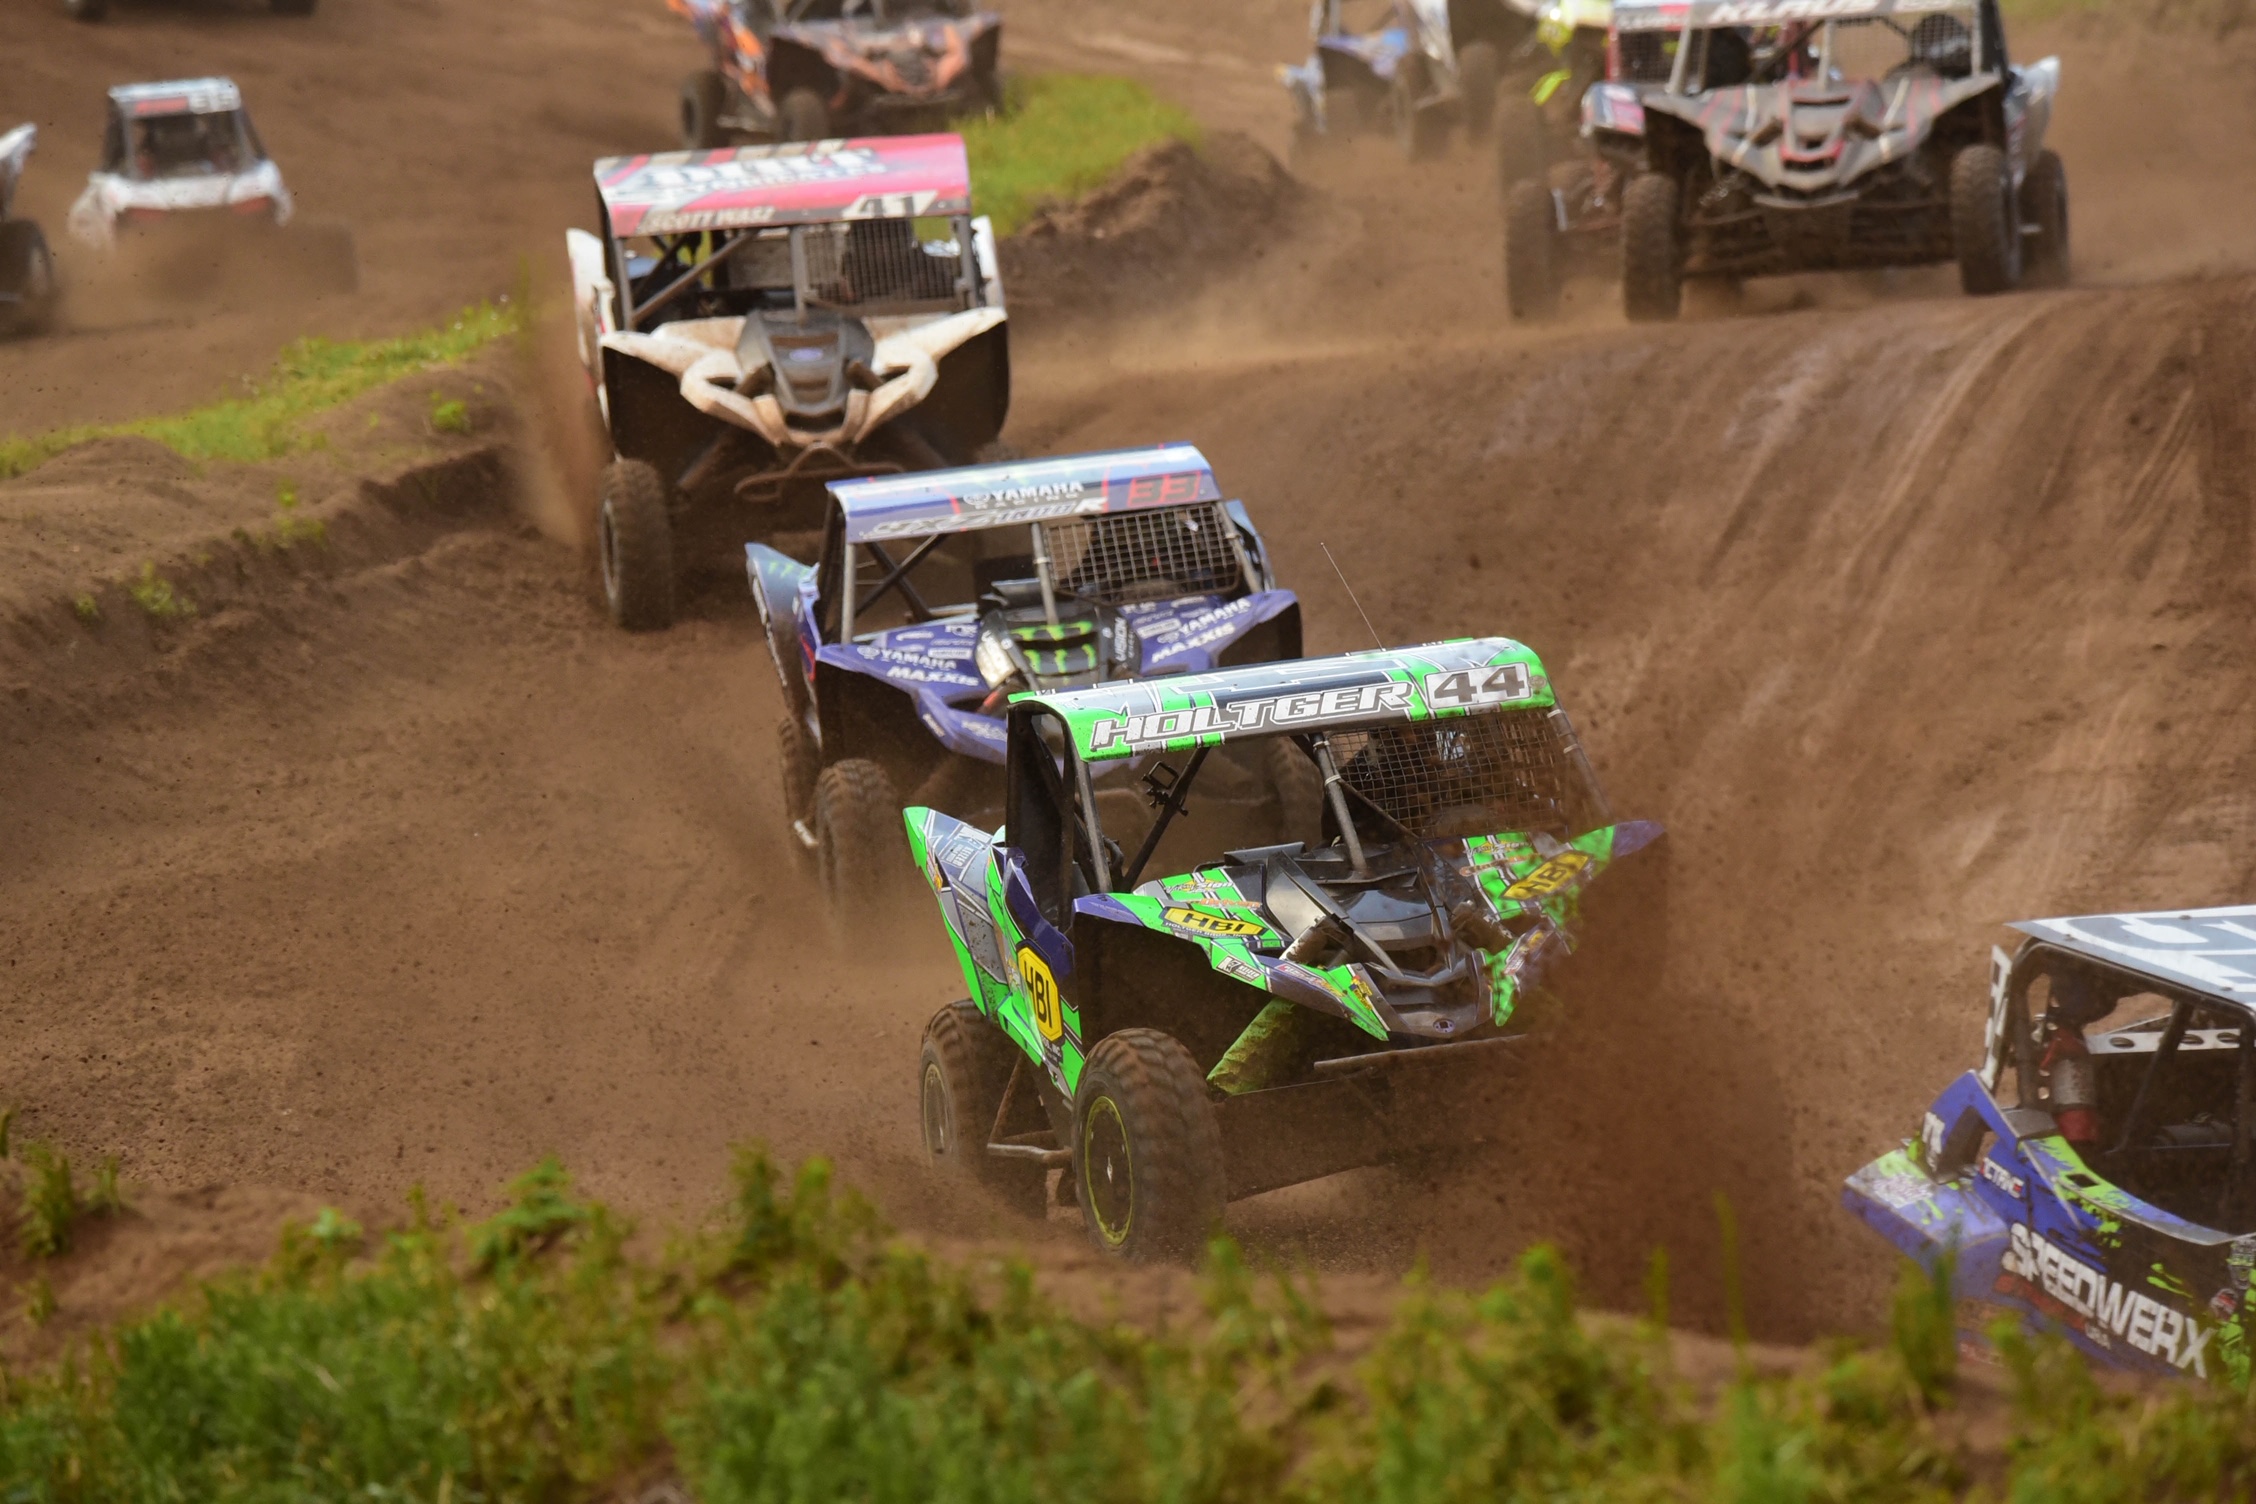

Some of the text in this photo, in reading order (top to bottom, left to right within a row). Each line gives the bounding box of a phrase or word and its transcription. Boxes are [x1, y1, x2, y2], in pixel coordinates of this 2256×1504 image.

[991, 480, 1084, 501] YAMAHA
[1180, 598, 1251, 636] YAMAHA
[881, 649, 957, 670] YAMAHA
[1152, 621, 1236, 663] MAXXIS
[887, 666, 979, 686] MAXXIS
[1433, 665, 1525, 702] 44
[1091, 681, 1412, 750] HOLTGER
[1182, 913, 1245, 932] HBI
[1023, 961, 1053, 1029] HBI
[2002, 1222, 2215, 1379] SPEEDWERX
